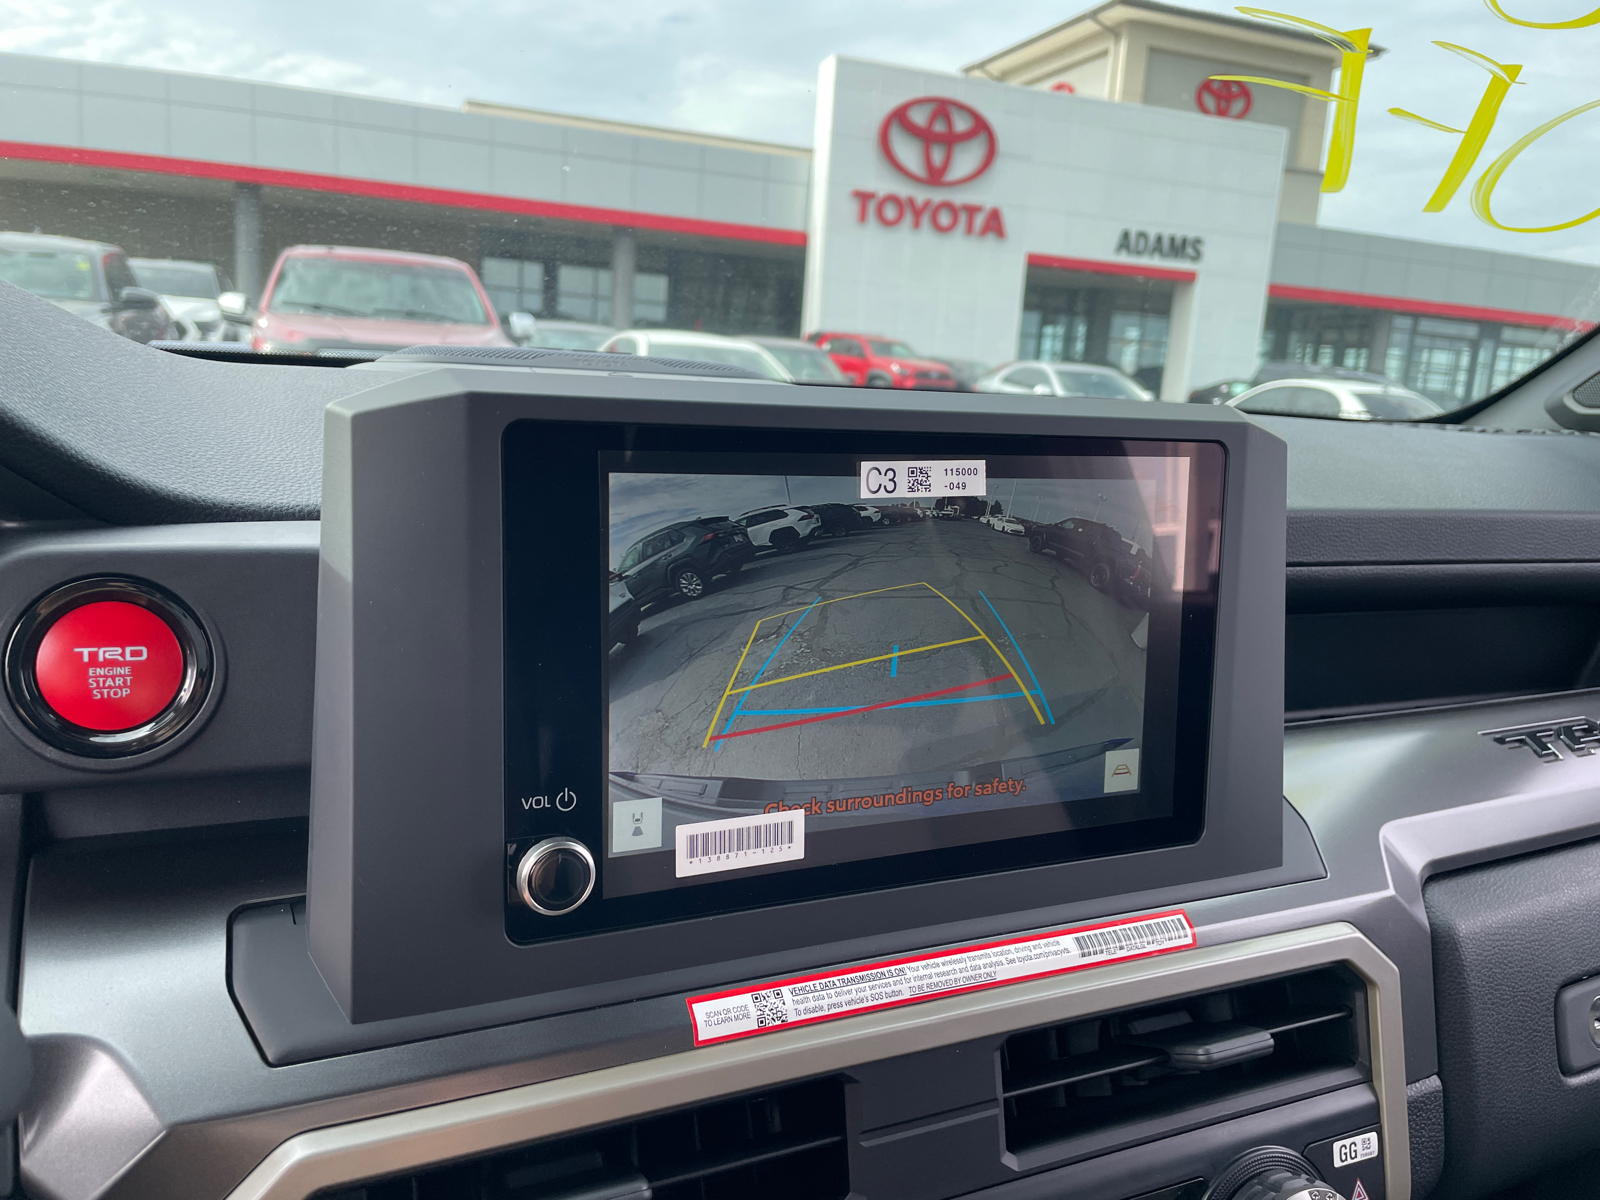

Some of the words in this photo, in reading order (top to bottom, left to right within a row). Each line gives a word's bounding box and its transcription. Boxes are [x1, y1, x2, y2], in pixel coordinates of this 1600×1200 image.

[851, 190, 1007, 239] TOYOTA
[1115, 228, 1204, 262] ADAMS
[866, 466, 897, 494] C3
[943, 467, 978, 477] 115000
[944, 481, 967, 491] -049
[73, 646, 148, 662] TRD
[88, 666, 132, 676] ENGINE
[88, 676, 133, 688] START
[92, 688, 131, 699] STOP
[521, 795, 551, 810] VOL
[826, 786, 943, 813] surroundings
[947, 781, 971, 800] for
[974, 777, 1026, 796] safety.
[788, 983, 818, 996] VEHICLE
[819, 979, 837, 990] DATA
[838, 969, 886, 987] TRANSMISSION
[887, 968, 894, 977] IS
[894, 966, 907, 976] ON!
[906, 964, 920, 974] Your
[921, 960, 940, 971] vehicle
[941, 956, 966, 967] wirelessly
[967, 952, 991, 962] transmits
[991, 948, 1014, 958] location,
[1014, 944, 1032, 954] driving
[1033, 942, 1042, 950] and
[1042, 939, 1061, 949] vehicle
[792, 996, 810, 1006] health
[812, 993, 825, 1002] data
[825, 992, 833, 1000] to
[834, 988, 853, 998] deliver
[854, 985, 867, 996] your
[868, 980, 892, 991] services
[893, 978, 903, 986] and
[904, 976, 912, 984] for
[913, 972, 933, 982] internal
[934, 967, 958, 978] research
[959, 965, 969, 974] and
[970, 962, 981, 972] data
[982, 959, 1005, 971] analysis.
[1005, 956, 1016, 965] See
[908, 985, 917, 994] TO
[918, 983, 926, 992] BE
[926, 979, 953, 990] REMOVED
[954, 976, 961, 985] BY
[962, 973, 983, 984] OWNER
[983, 970, 997, 980] ONLY
[705, 1008, 721, 1020] SCAN
[722, 1007, 732, 1016] QR
[733, 1004, 749, 1014] CODE
[794, 1007, 801, 1017] To
[802, 1003, 826, 1015] disable,
[827, 1000, 844, 1013] press
[844, 995, 869, 1007] vehicle's
[870, 991, 884, 1002] SOS
[884, 988, 904, 999] button.
[704, 1019, 713, 1028] TO
[713, 1015, 733, 1026] LEARN
[734, 1011, 751, 1022] MORE
[1339, 1141, 1358, 1163] GG
